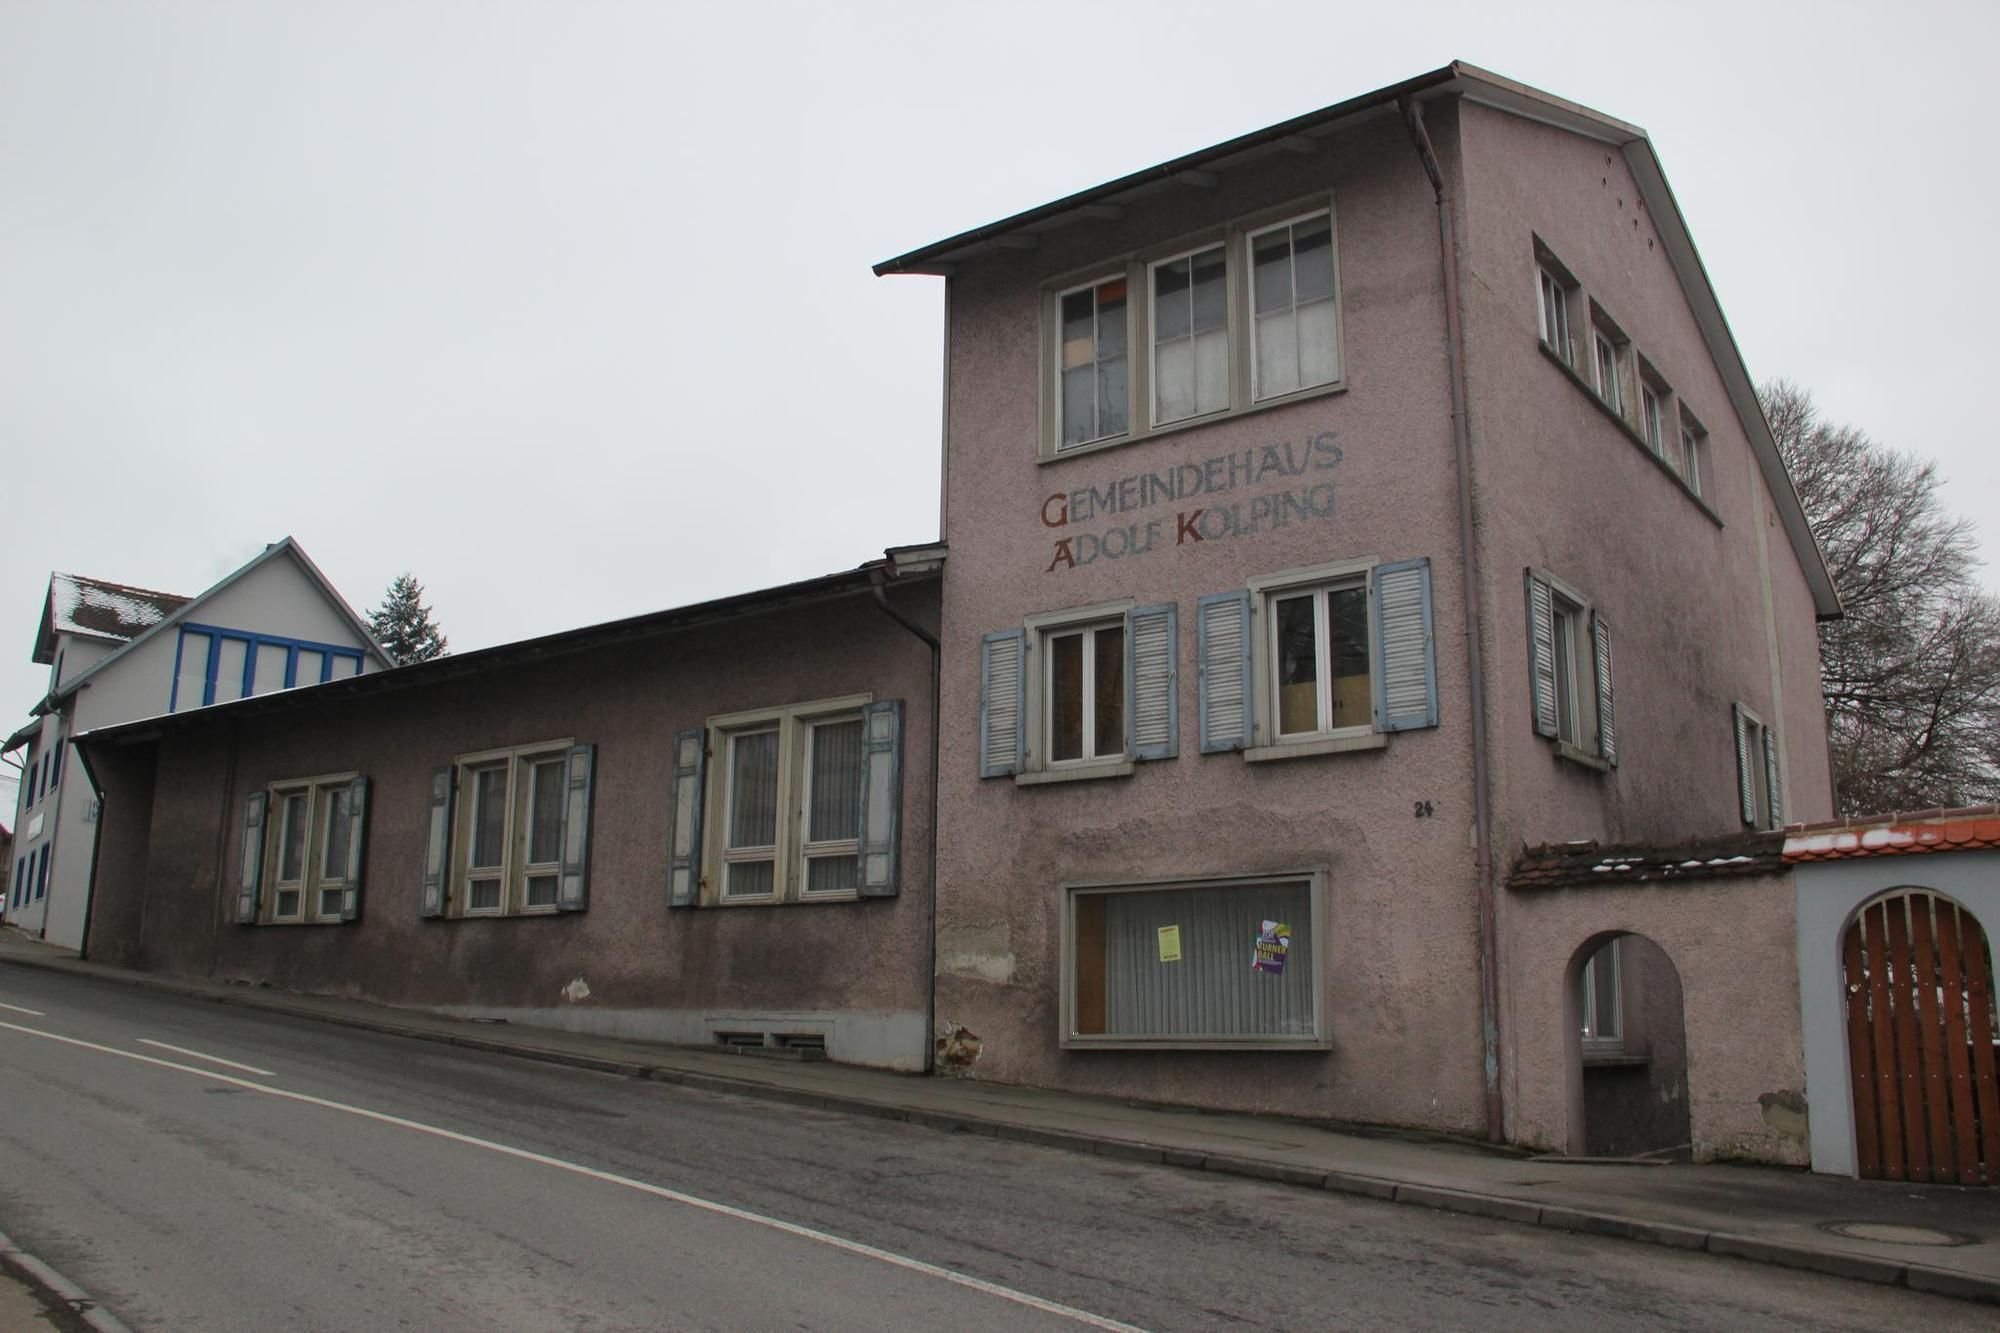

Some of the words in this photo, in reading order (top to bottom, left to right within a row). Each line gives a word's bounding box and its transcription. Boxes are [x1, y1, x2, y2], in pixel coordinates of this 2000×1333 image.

[1041, 431, 1343, 528] GEMEINDEHAUS
[1046, 521, 1161, 573] ADOLF
[1176, 484, 1336, 546] KOLPING
[1414, 800, 1433, 818] 24
